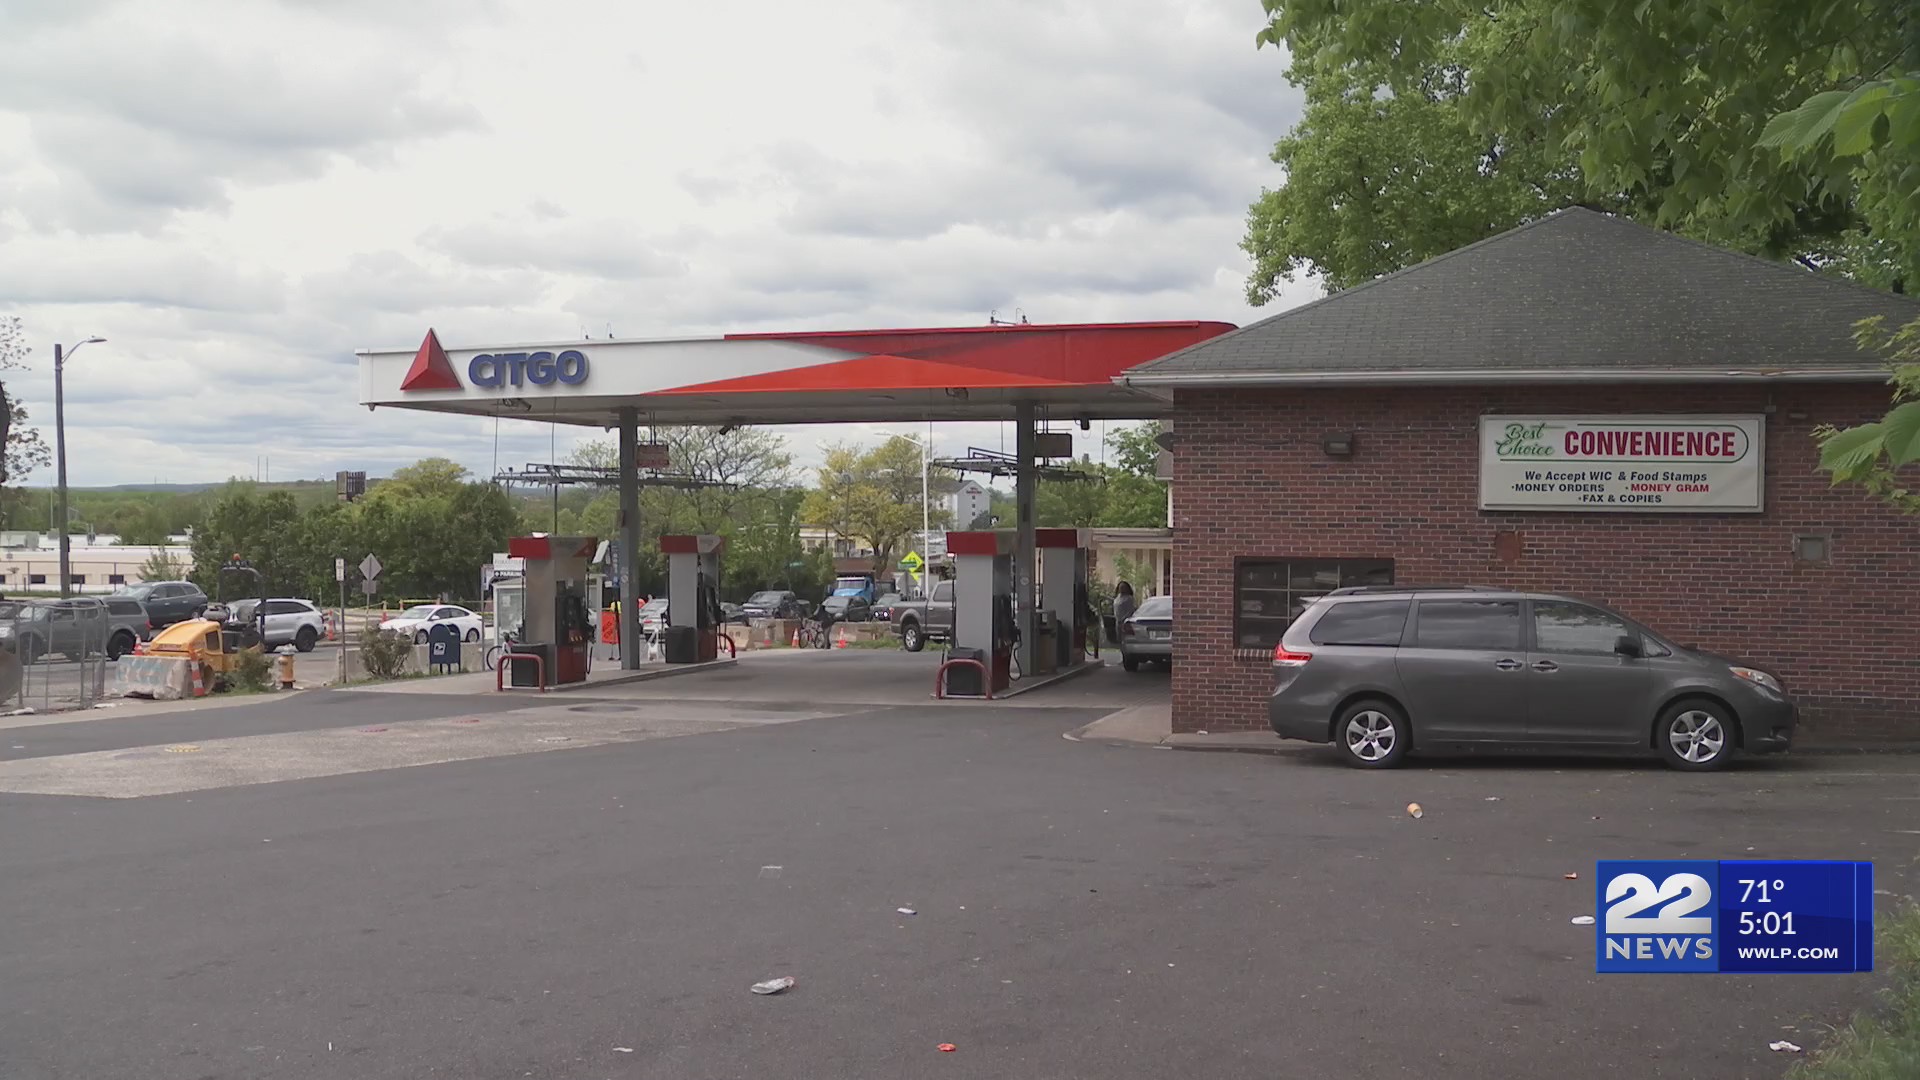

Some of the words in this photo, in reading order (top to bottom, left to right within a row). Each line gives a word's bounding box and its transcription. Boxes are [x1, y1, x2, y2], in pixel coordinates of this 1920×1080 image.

[468, 349, 590, 389] CITGO
[1495, 439, 1555, 457] Choice
[1564, 431, 1736, 456] CONVENIENCE
[1525, 471, 1542, 481] We
[1545, 471, 1586, 484] Accept
[1589, 471, 1612, 482] WIC
[1618, 471, 1627, 482] &
[1630, 472, 1659, 482] Food
[1662, 472, 1708, 484] Stamps
[1559, 484, 1605, 493] ORDERS
[1676, 484, 1710, 493] GRAM
[1608, 494, 1616, 503] &
[1619, 495, 1662, 503] COPIES
